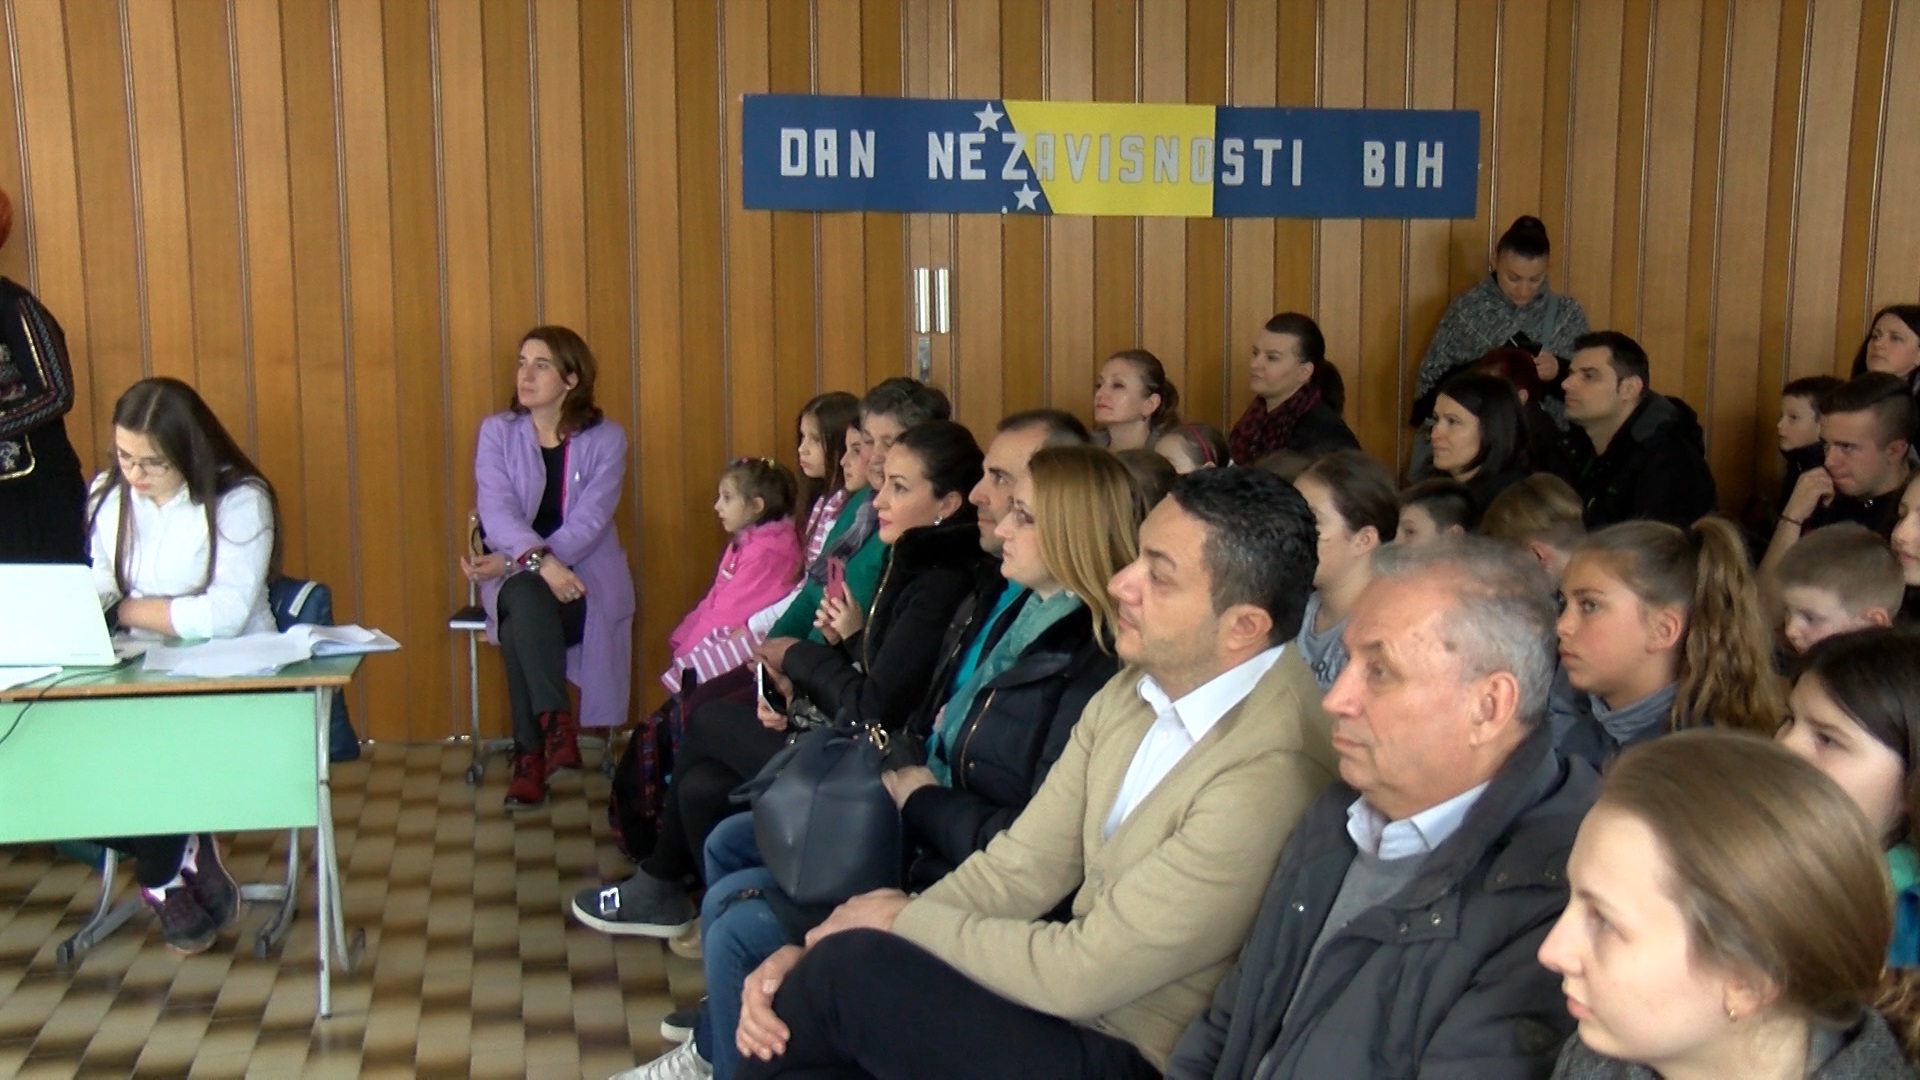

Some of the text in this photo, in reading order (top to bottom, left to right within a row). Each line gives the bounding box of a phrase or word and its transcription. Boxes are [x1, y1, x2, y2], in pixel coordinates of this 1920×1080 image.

[780, 128, 1444, 188] DAN NEZAVISNOSTI BIH
